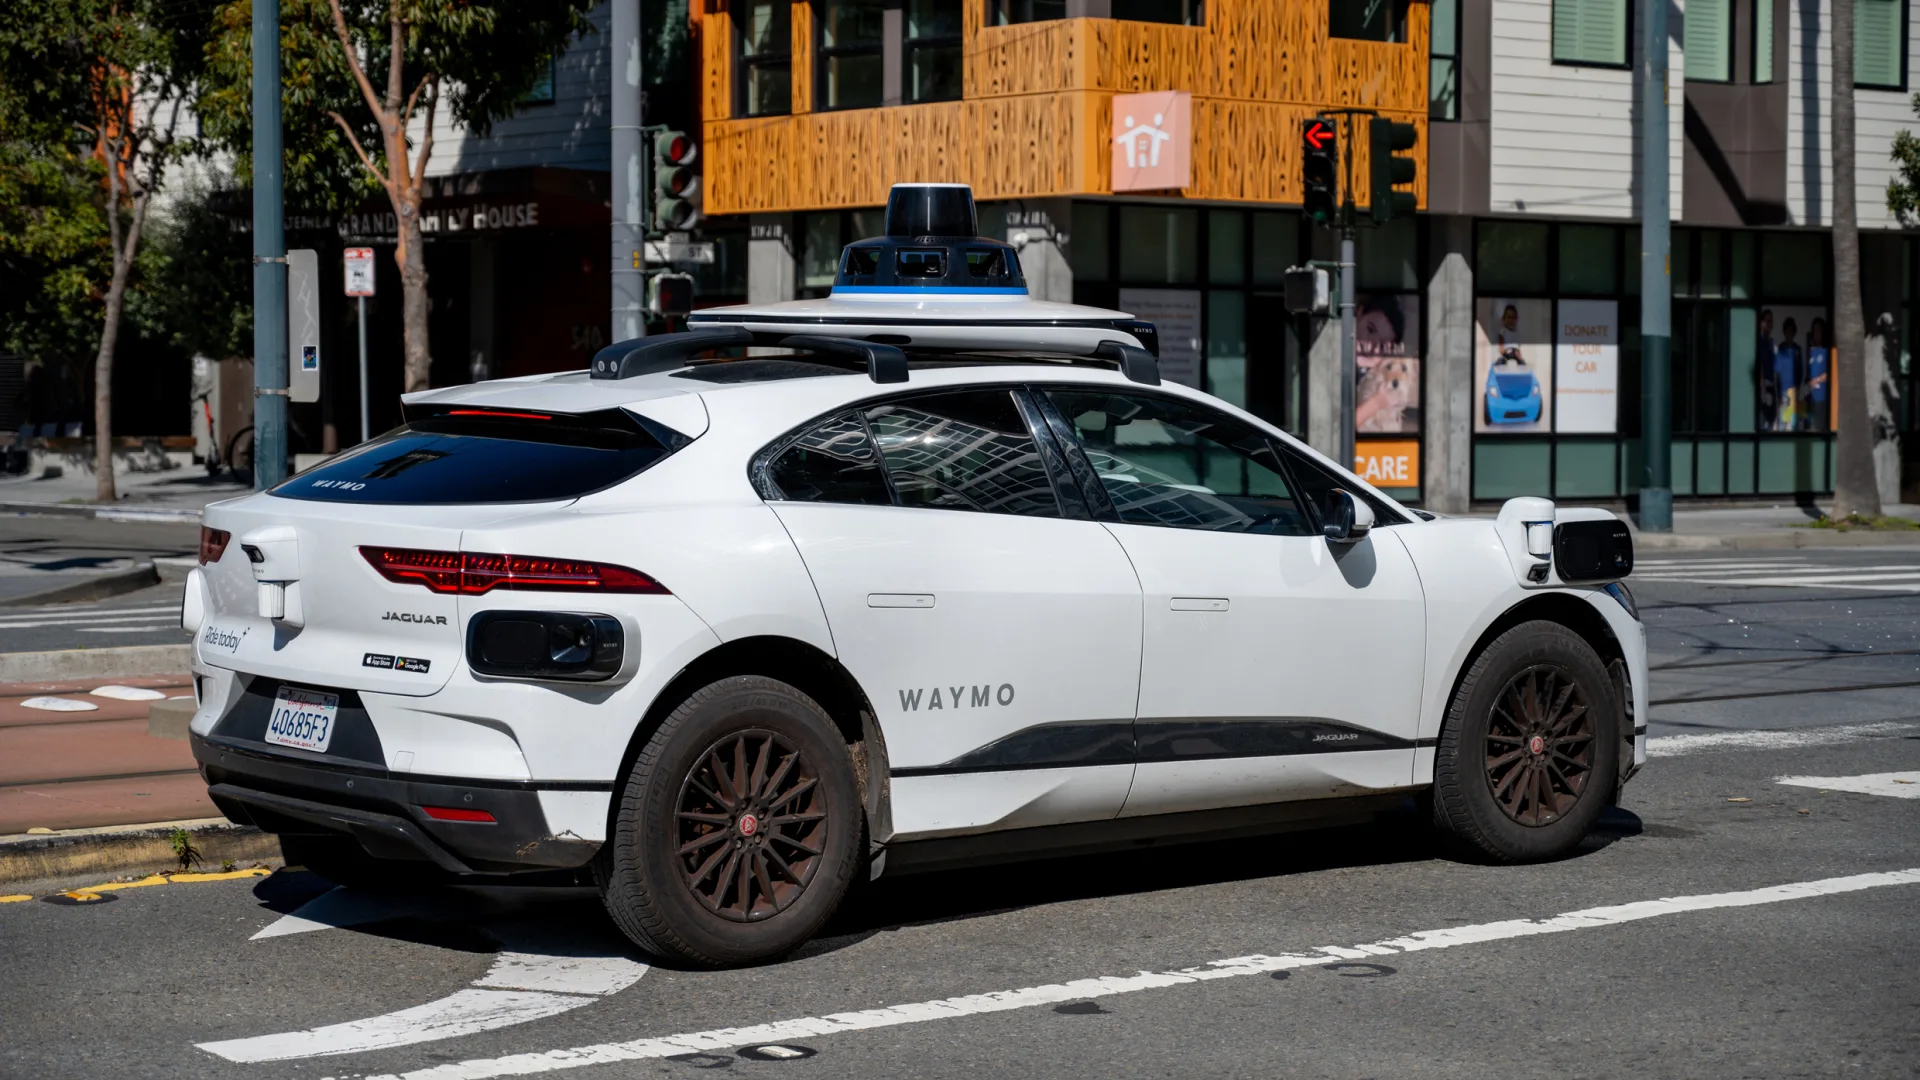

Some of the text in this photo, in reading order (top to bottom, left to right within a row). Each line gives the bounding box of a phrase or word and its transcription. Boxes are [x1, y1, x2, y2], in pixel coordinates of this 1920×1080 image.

[473, 203, 539, 230] HOUSE
[1564, 325, 1609, 337] DONATE
[1572, 343, 1602, 355] YOUR
[1575, 361, 1598, 373] CAR
[311, 479, 367, 492] WAYMO
[381, 611, 448, 626] JAGUAR
[204, 626, 241, 654] Ride today
[898, 683, 1015, 712] WAYMO
[271, 708, 329, 742] 40685F3
[1312, 733, 1359, 742] JAGUAR
